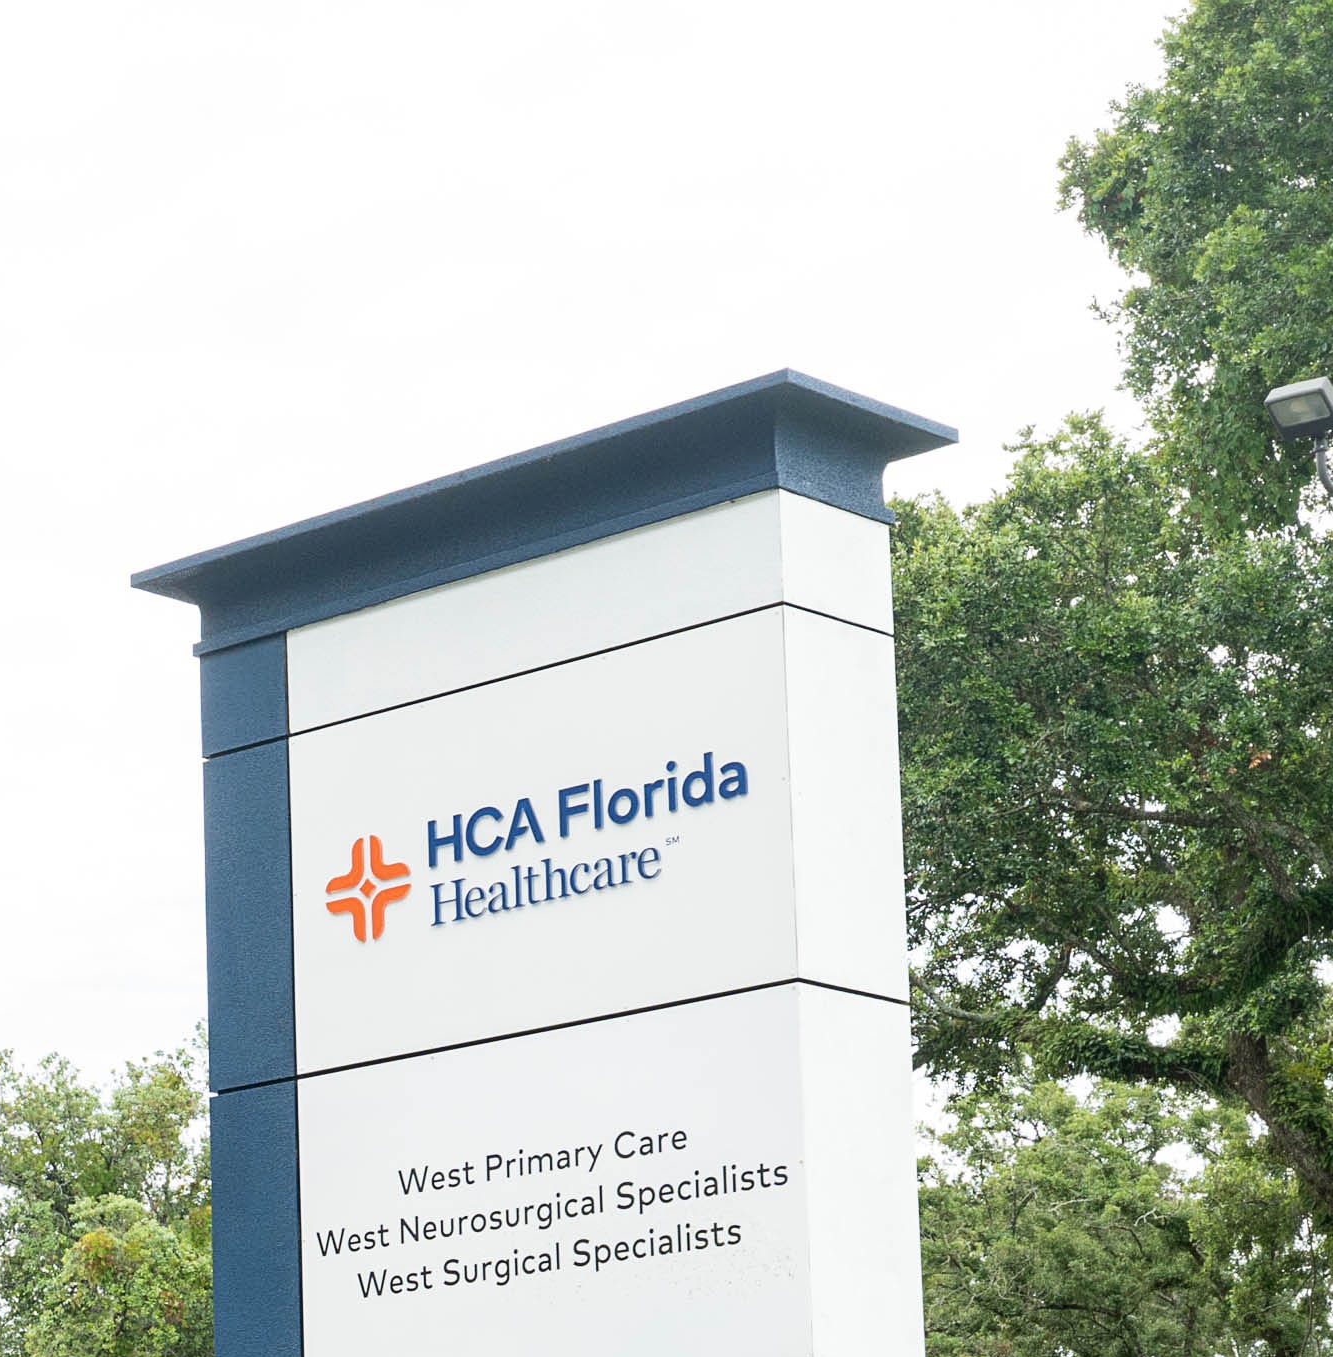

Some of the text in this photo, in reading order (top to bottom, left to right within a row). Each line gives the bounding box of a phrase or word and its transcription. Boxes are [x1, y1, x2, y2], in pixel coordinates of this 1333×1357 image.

[427, 751, 749, 870] HCA Florida
[429, 847, 662, 927] Healthcare
[398, 1130, 688, 1196] West Primary Care
[316, 1163, 788, 1257] West Neurosurgical Specialists
[357, 1222, 742, 1299] West Surgical Specialists
